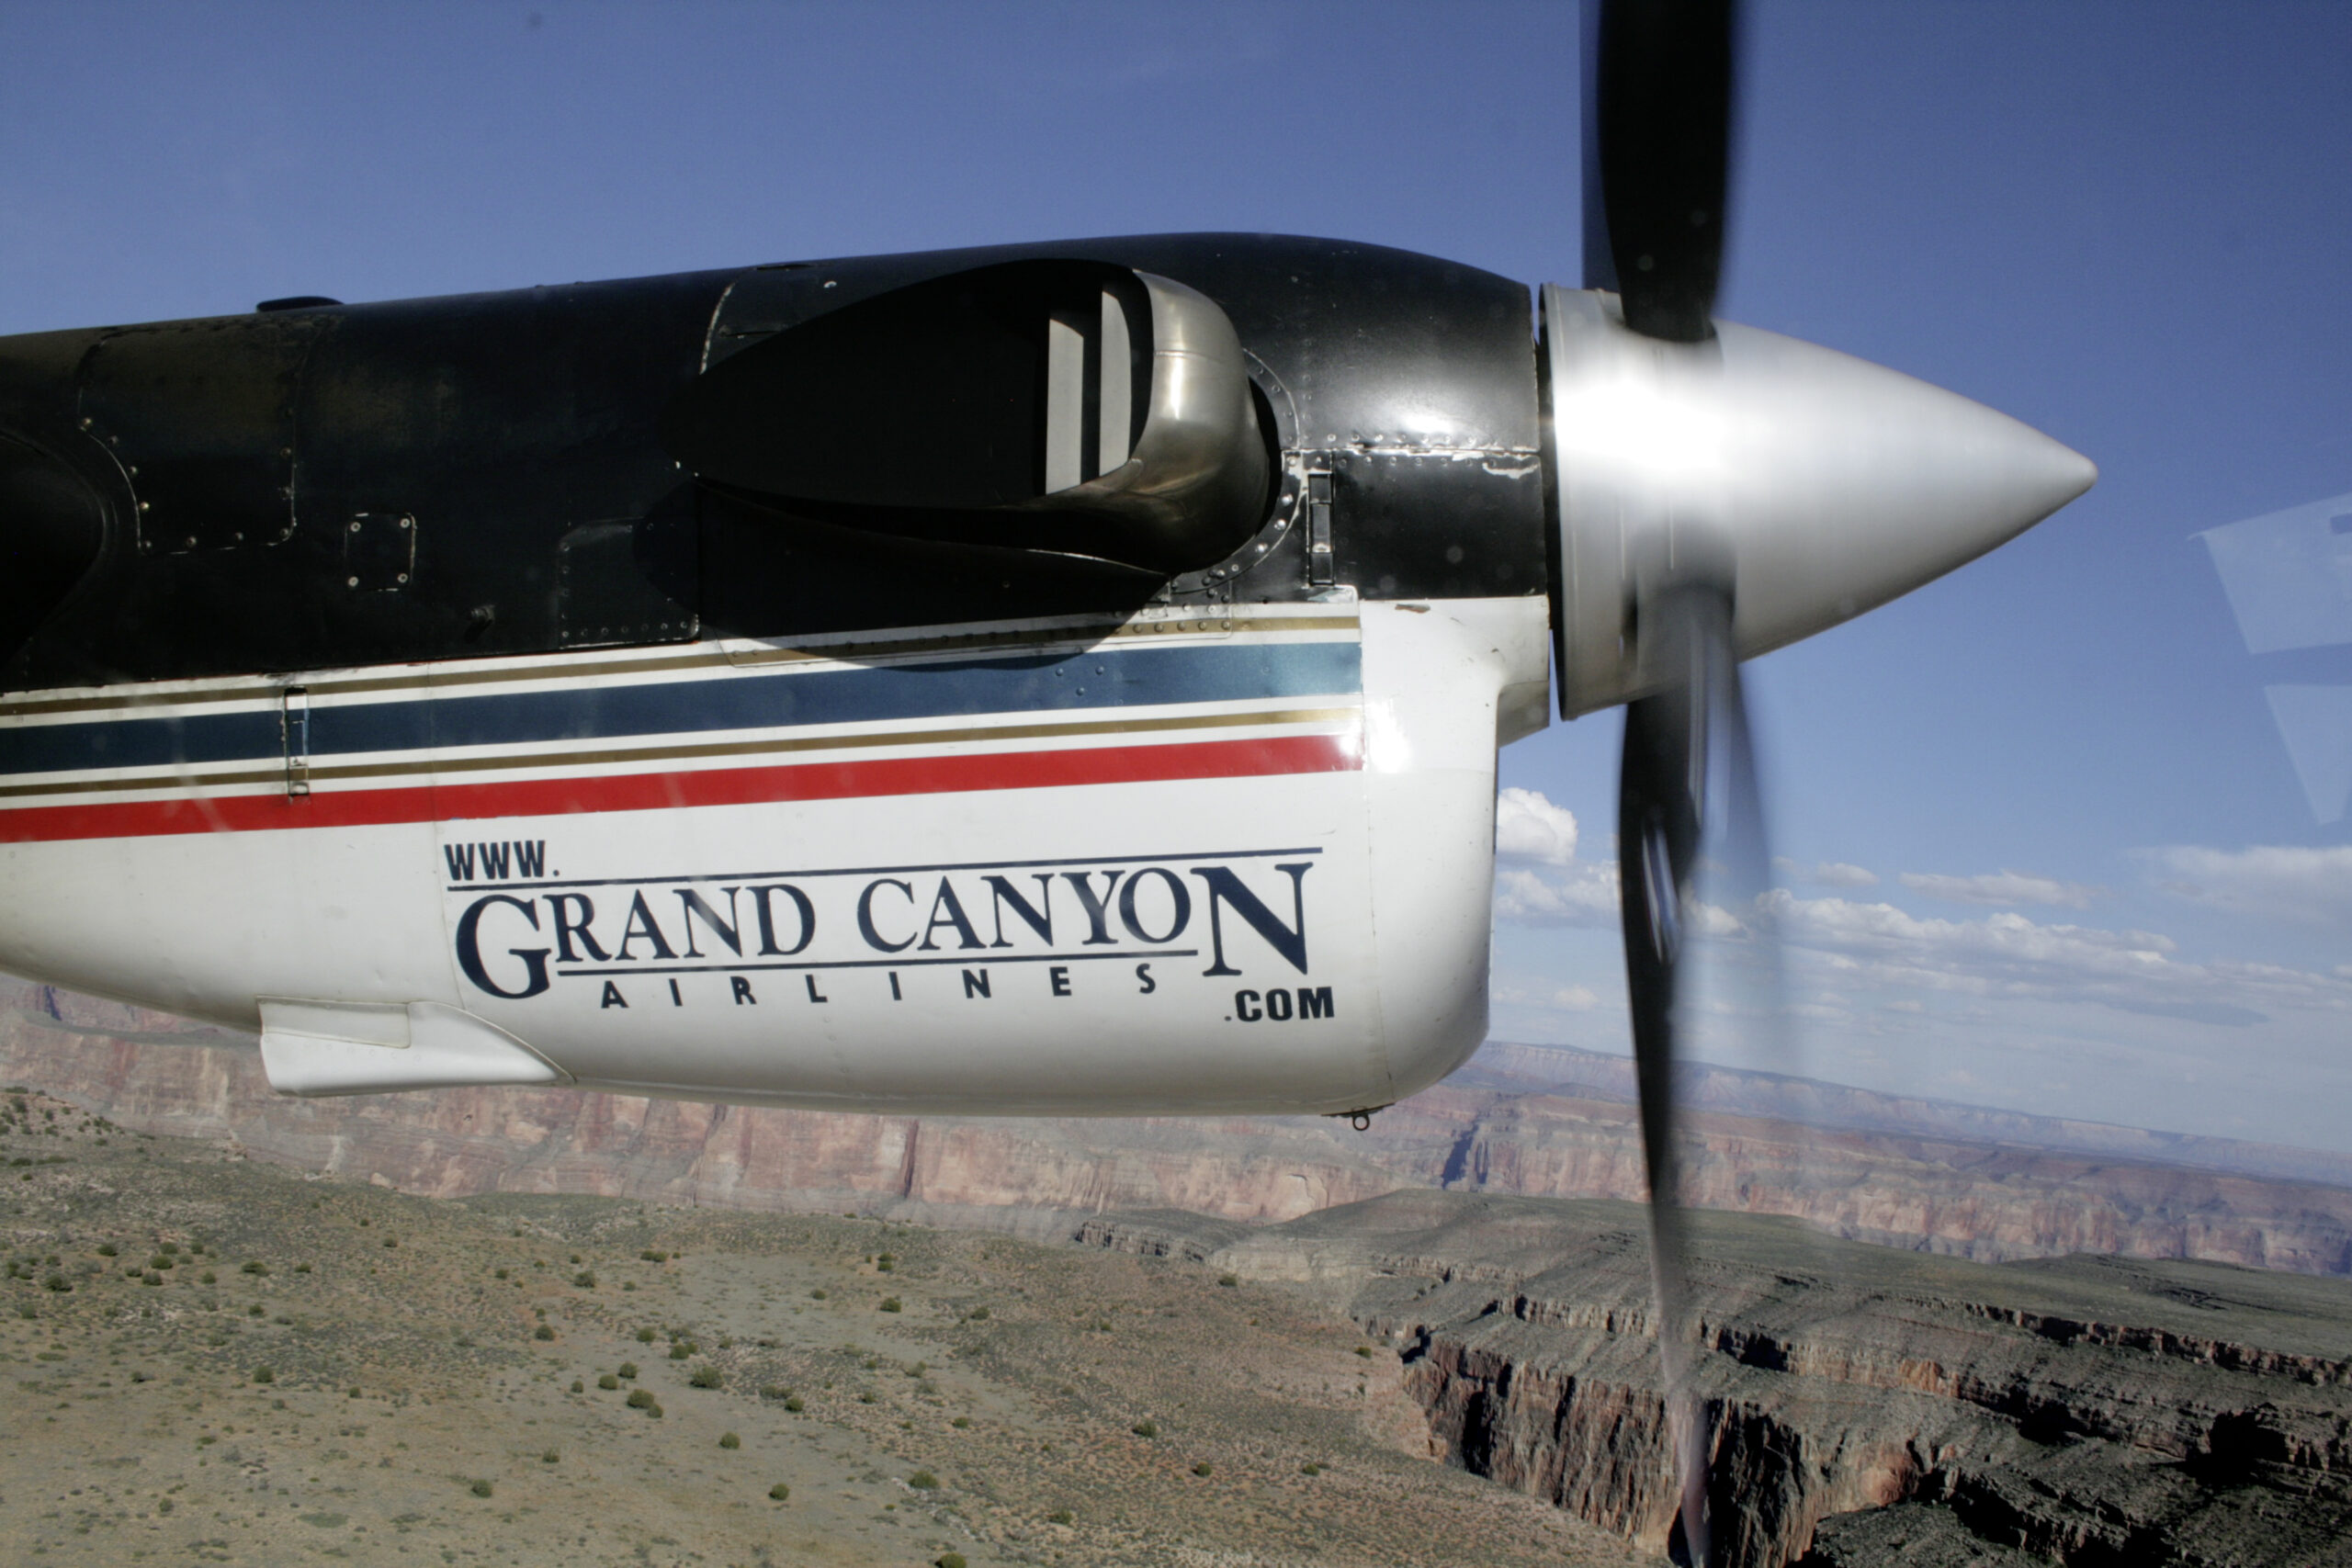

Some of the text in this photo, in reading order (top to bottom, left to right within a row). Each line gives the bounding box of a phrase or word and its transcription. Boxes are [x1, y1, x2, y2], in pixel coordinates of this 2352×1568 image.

[455, 862, 1314, 999] GRAND CANYON
[600, 963, 1157, 1009] AIRLINES
[1224, 986, 1335, 1023] .COM
